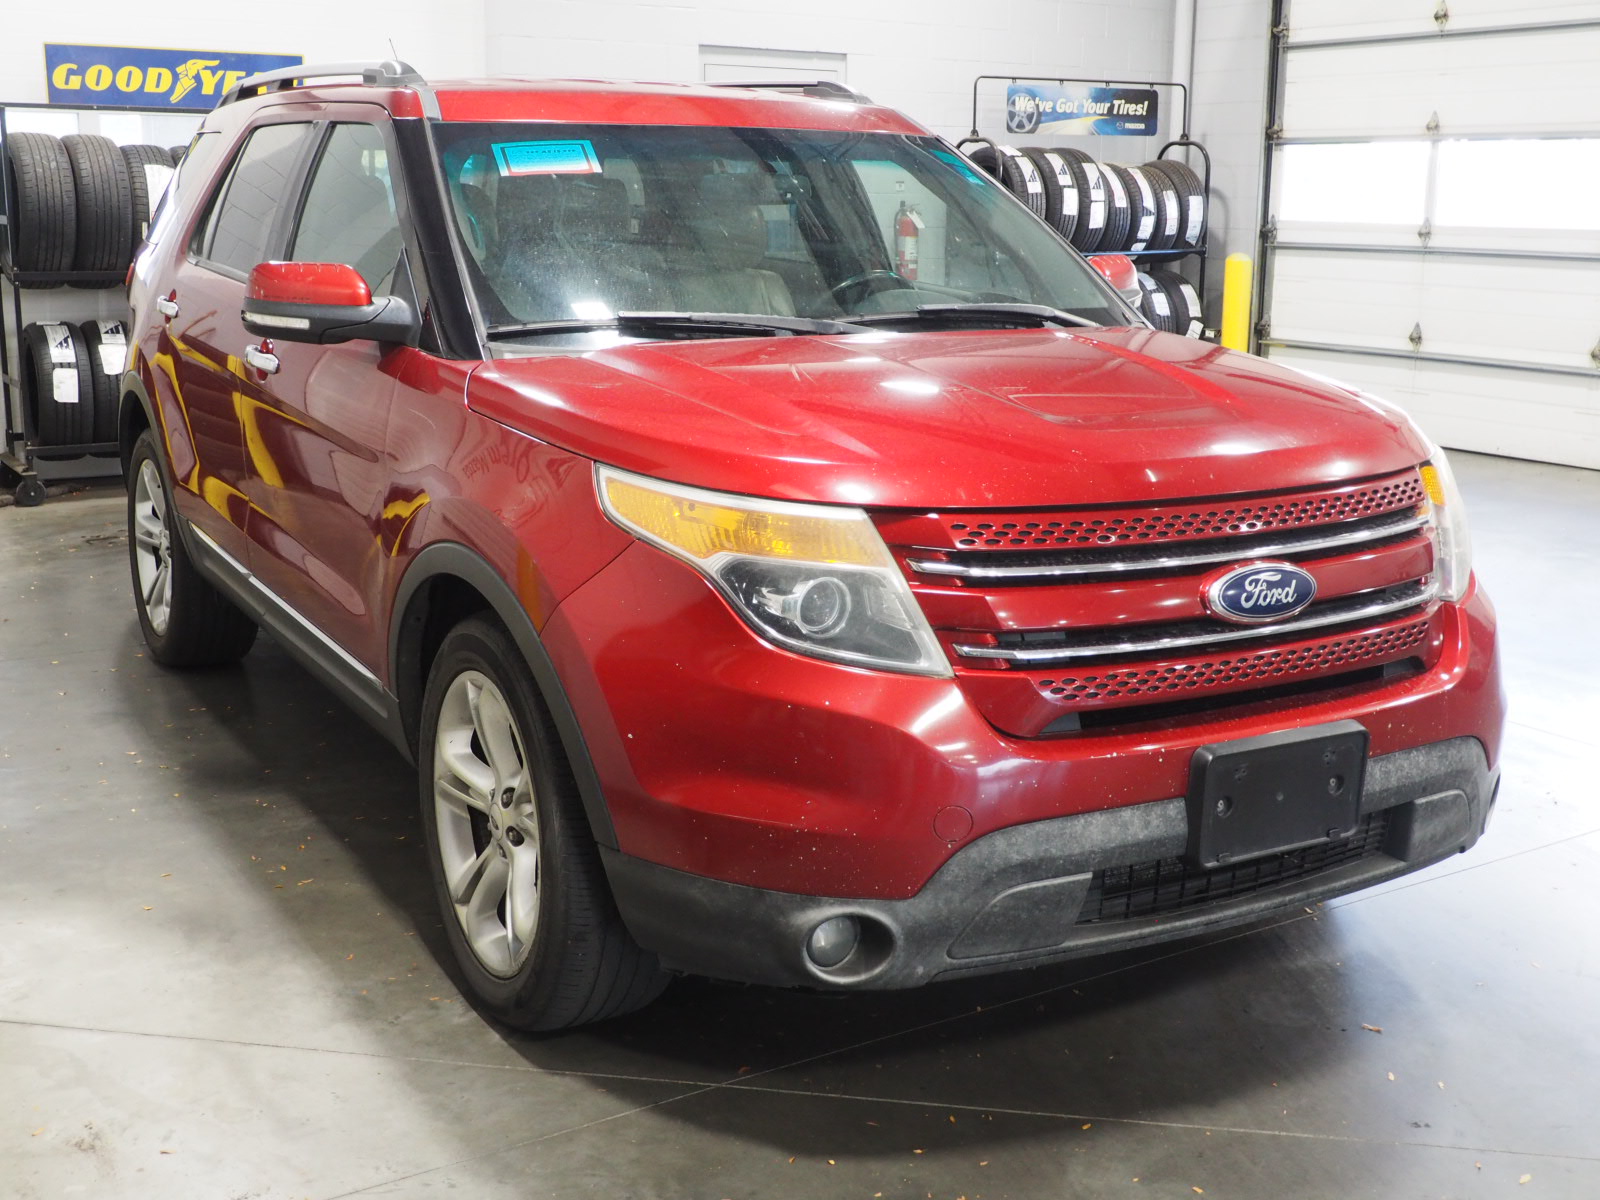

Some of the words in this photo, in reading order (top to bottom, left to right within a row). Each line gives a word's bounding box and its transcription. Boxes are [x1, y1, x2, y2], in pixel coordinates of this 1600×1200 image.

[52, 63, 299, 96] GOODYE
[1015, 96, 1053, 112] We've
[1056, 98, 1079, 113] Got
[1082, 98, 1111, 115] Your
[1112, 99, 1148, 116] Tires!
[1240, 572, 1297, 608] Ford
